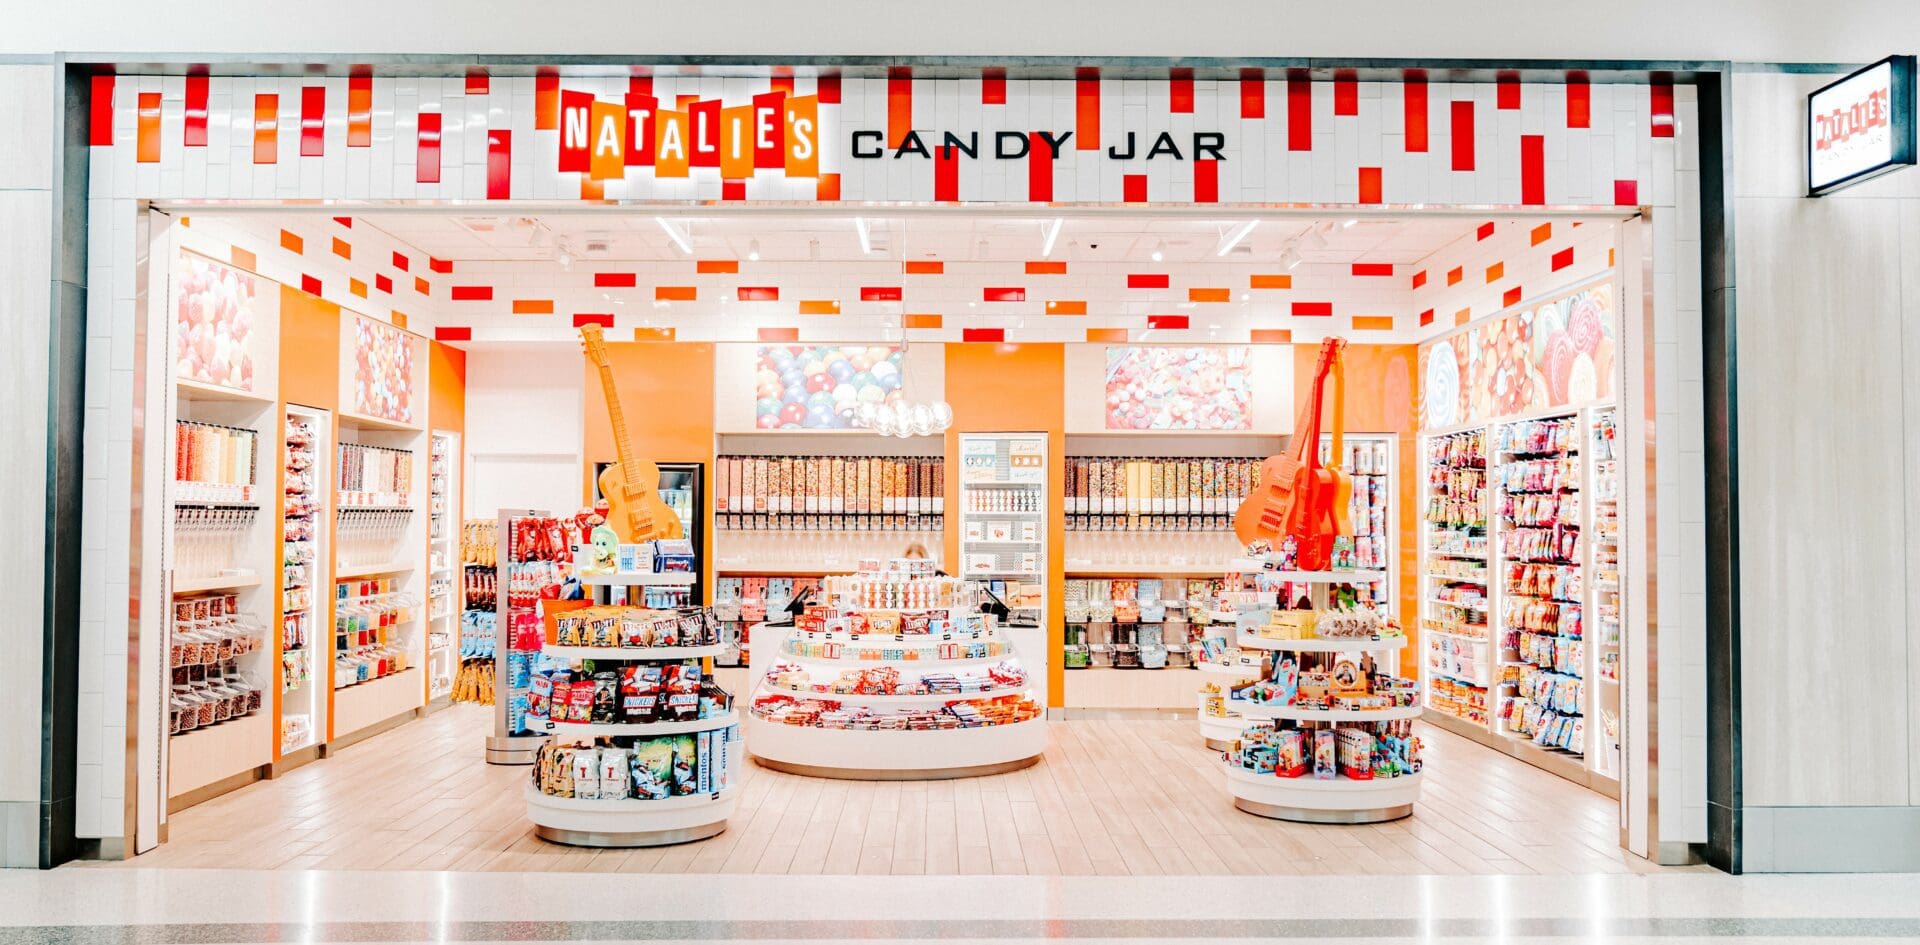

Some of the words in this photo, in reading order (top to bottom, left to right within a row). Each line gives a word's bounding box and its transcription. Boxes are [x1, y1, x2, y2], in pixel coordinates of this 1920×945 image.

[564, 106, 813, 161] NATALIE'S
[851, 130, 1073, 160] CANDY
[1109, 131, 1227, 161] JAR
[624, 696, 656, 707] SNICKERS
